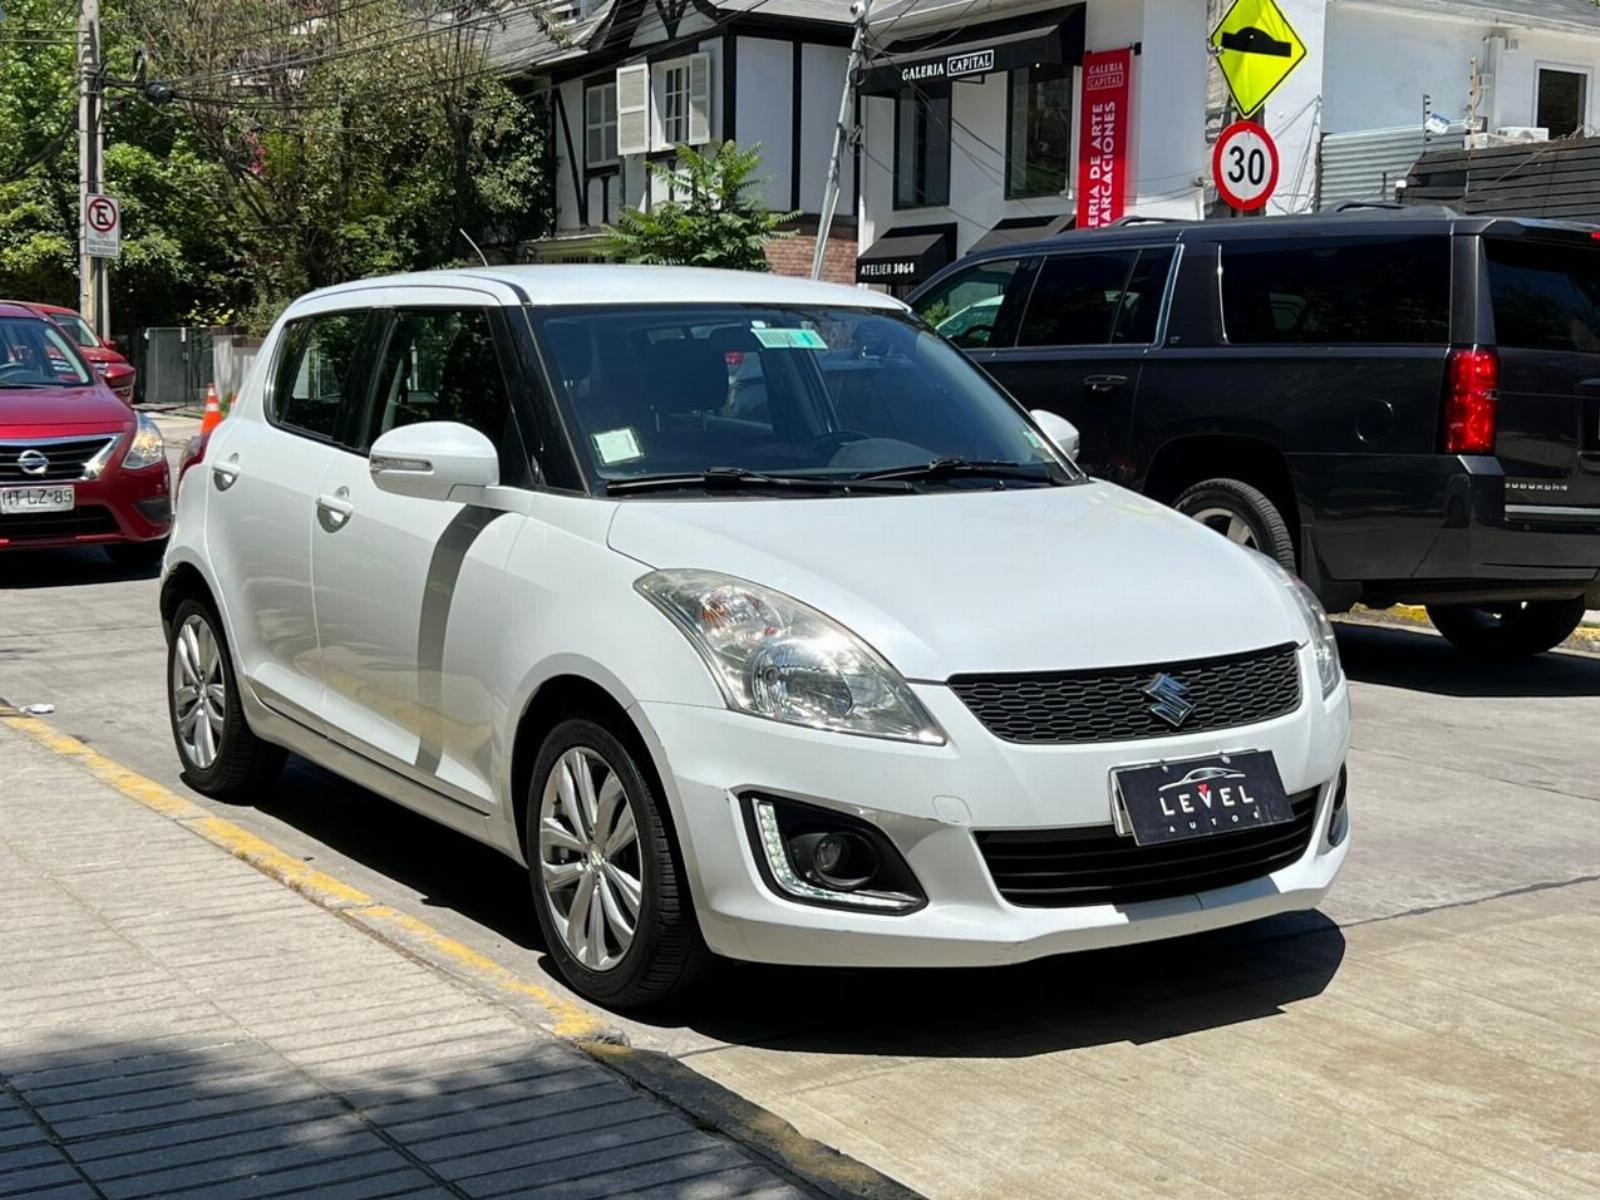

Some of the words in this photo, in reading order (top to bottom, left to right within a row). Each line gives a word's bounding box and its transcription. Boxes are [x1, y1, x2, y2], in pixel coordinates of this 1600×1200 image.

[902, 63, 944, 80] GALERIA
[950, 55, 990, 72] CAPITAL
[1089, 62, 1123, 75] GALERIA
[1089, 74, 1121, 88] CAPITAL
[1091, 103, 1103, 149] ARTE
[1089, 156, 1101, 179] DE
[1100, 101, 1115, 227] ARCACIONES
[1228, 146, 1265, 185] 30
[1088, 185, 1100, 228] ERIA
[860, 263, 892, 275] ATELIER
[1159, 785, 1254, 816] LEVEL
